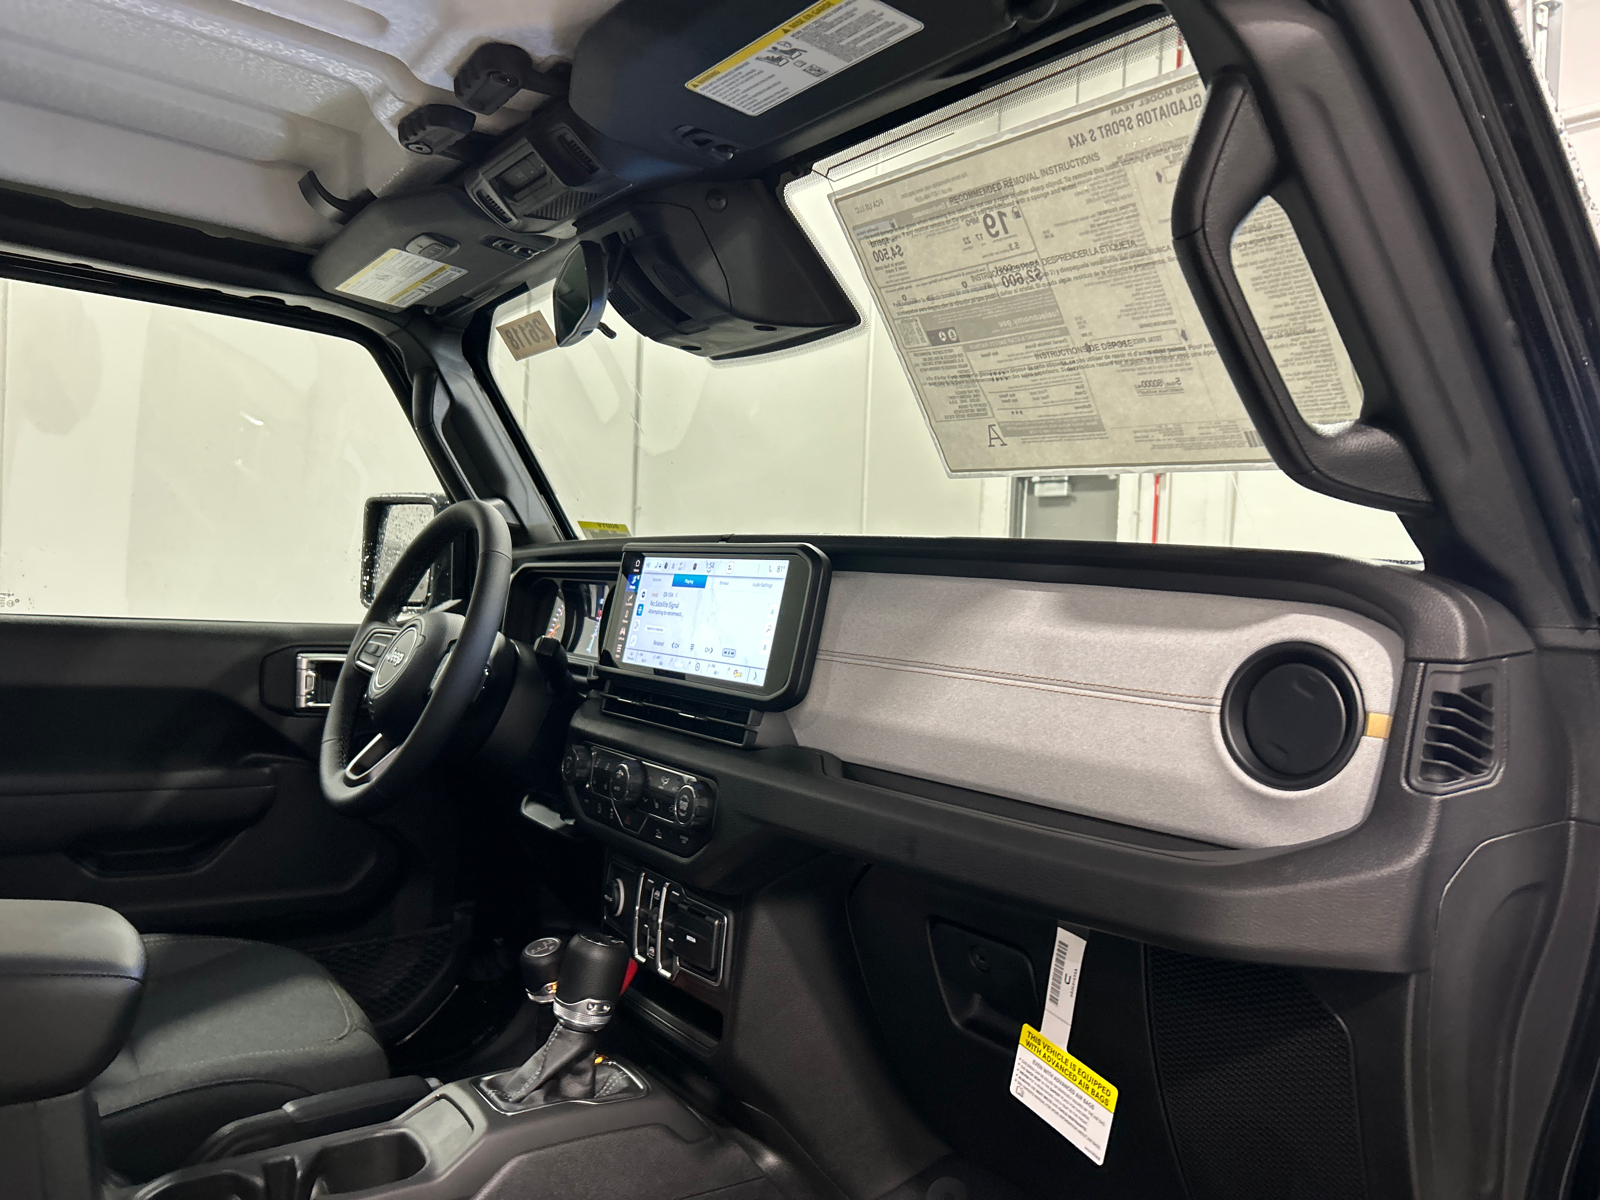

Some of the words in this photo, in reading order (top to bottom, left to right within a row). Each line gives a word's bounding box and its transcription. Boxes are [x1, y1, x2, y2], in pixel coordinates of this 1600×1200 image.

[949, 181, 1003, 206] RECOMMENDED
[1003, 172, 1039, 188] REMOVAL
[1040, 153, 1100, 177] INSTRUCTIONS
[1072, 170, 1093, 180] remove
[1031, 192, 1049, 200] sponge
[1051, 187, 1061, 195] and
[1041, 249, 1089, 266] DESPRENDER
[1088, 247, 1099, 256] LA
[1099, 240, 1137, 253] ETIQUETA
[1034, 345, 1088, 359] INSTRUCTIONS
[1101, 339, 1133, 350] DÉPOSE
[669, 601, 680, 610] Signal
[386, 647, 405, 667] Jeep
[1026, 1039, 1041, 1055] WITH
[1042, 1053, 1077, 1081] ADVANCED
[1078, 1080, 1089, 1091] AIR
[1091, 1088, 1108, 1106] BAGS
[1028, 1031, 1041, 1045] THIS
[1042, 1042, 1068, 1066] VEHICLE
[1070, 1062, 1076, 1071] IS
[1078, 1068, 1111, 1096] EQUIPPED
